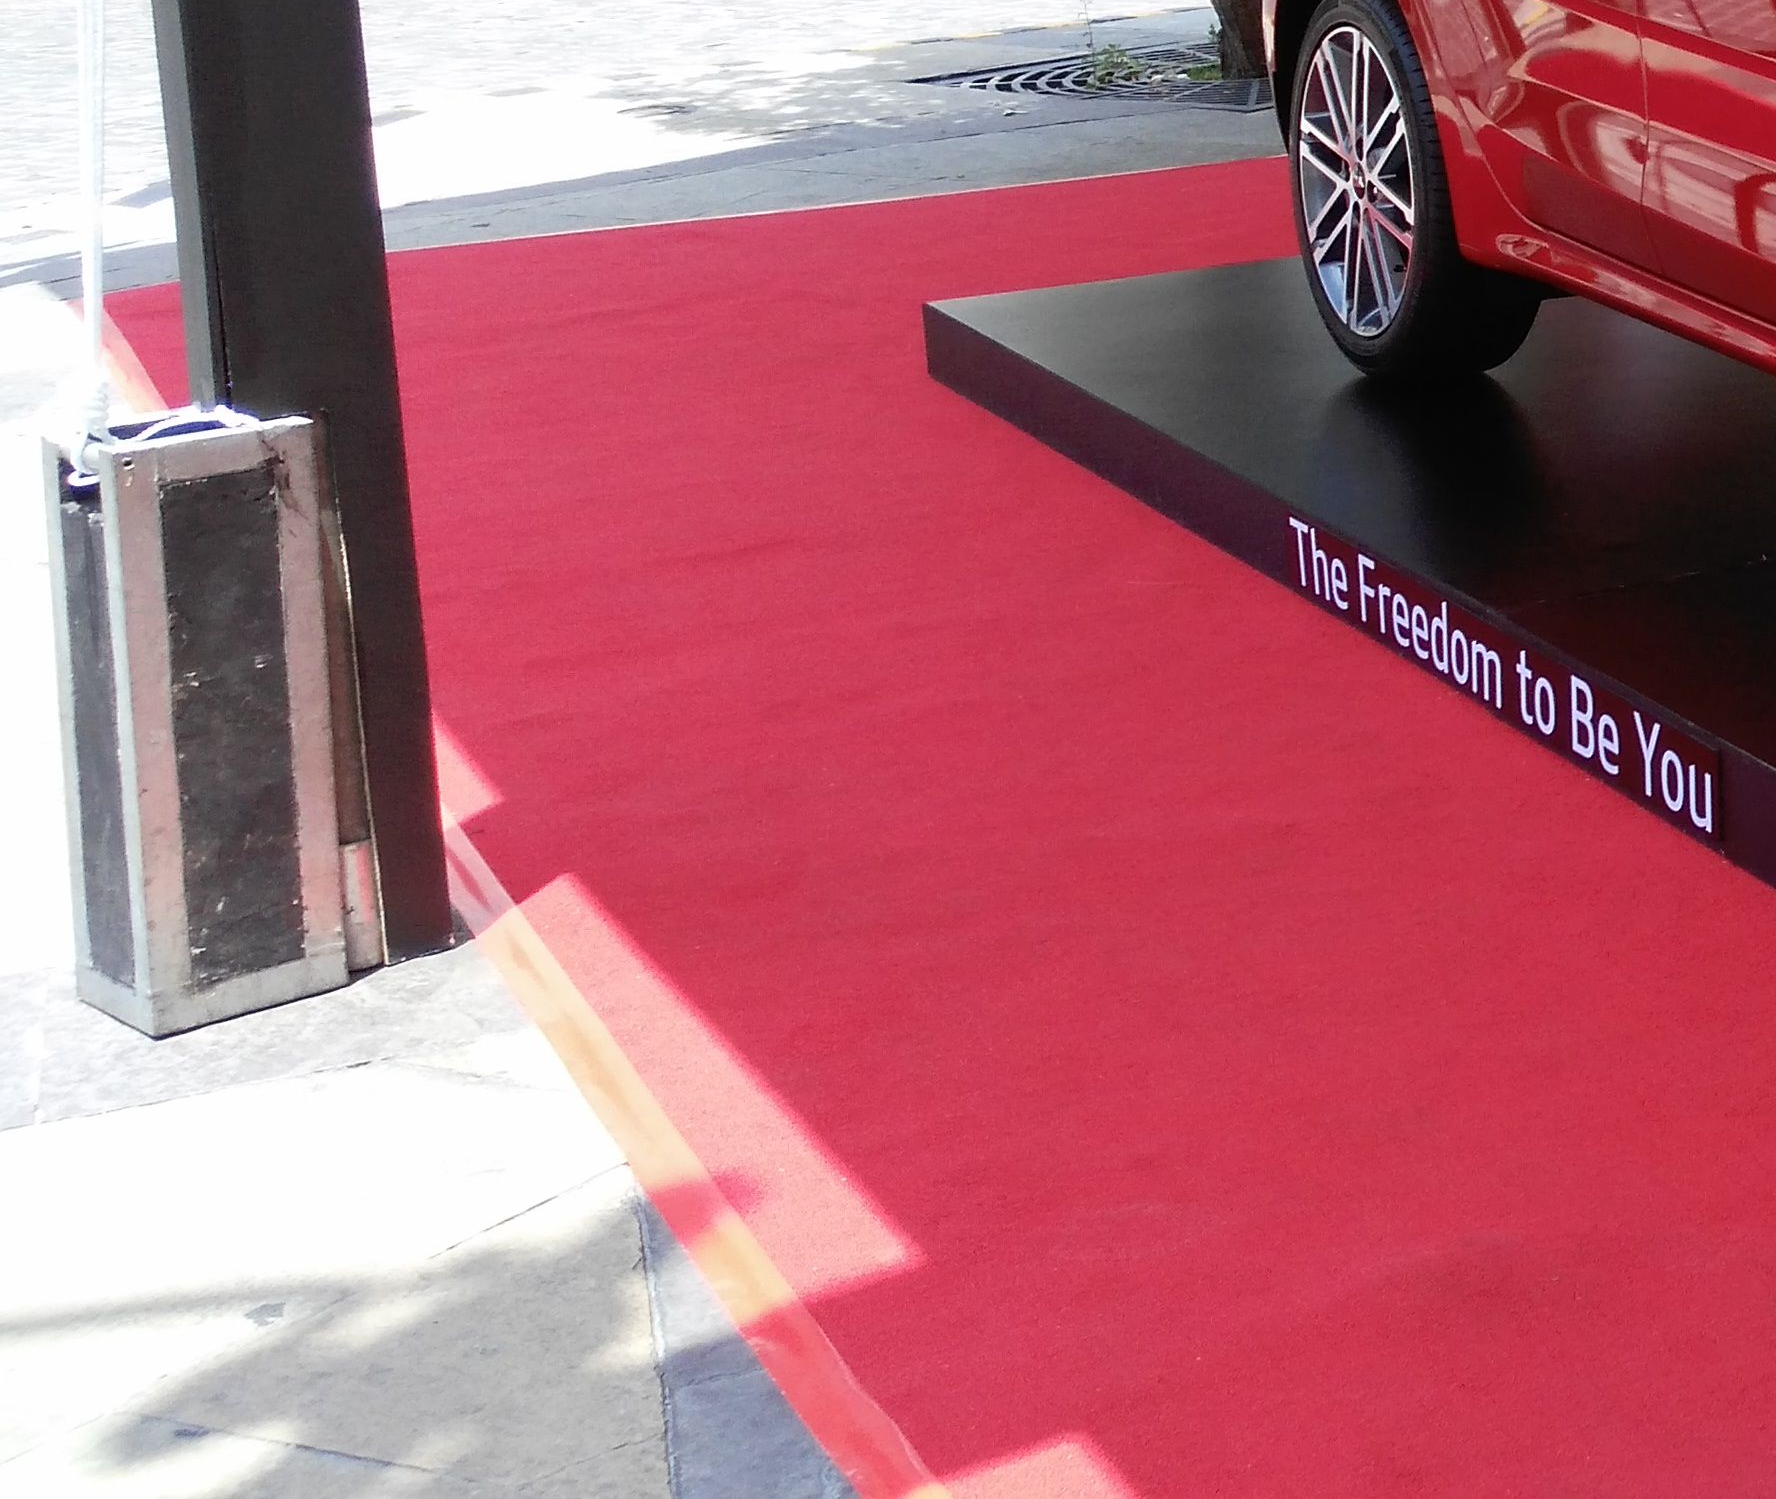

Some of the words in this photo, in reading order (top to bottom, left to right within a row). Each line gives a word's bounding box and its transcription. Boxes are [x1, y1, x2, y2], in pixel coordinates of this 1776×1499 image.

[1290, 517, 1348, 610] The
[1358, 553, 1502, 709] Freedom
[1516, 650, 1556, 735] to
[1571, 675, 1620, 775] Be
[1633, 710, 1713, 833] You
